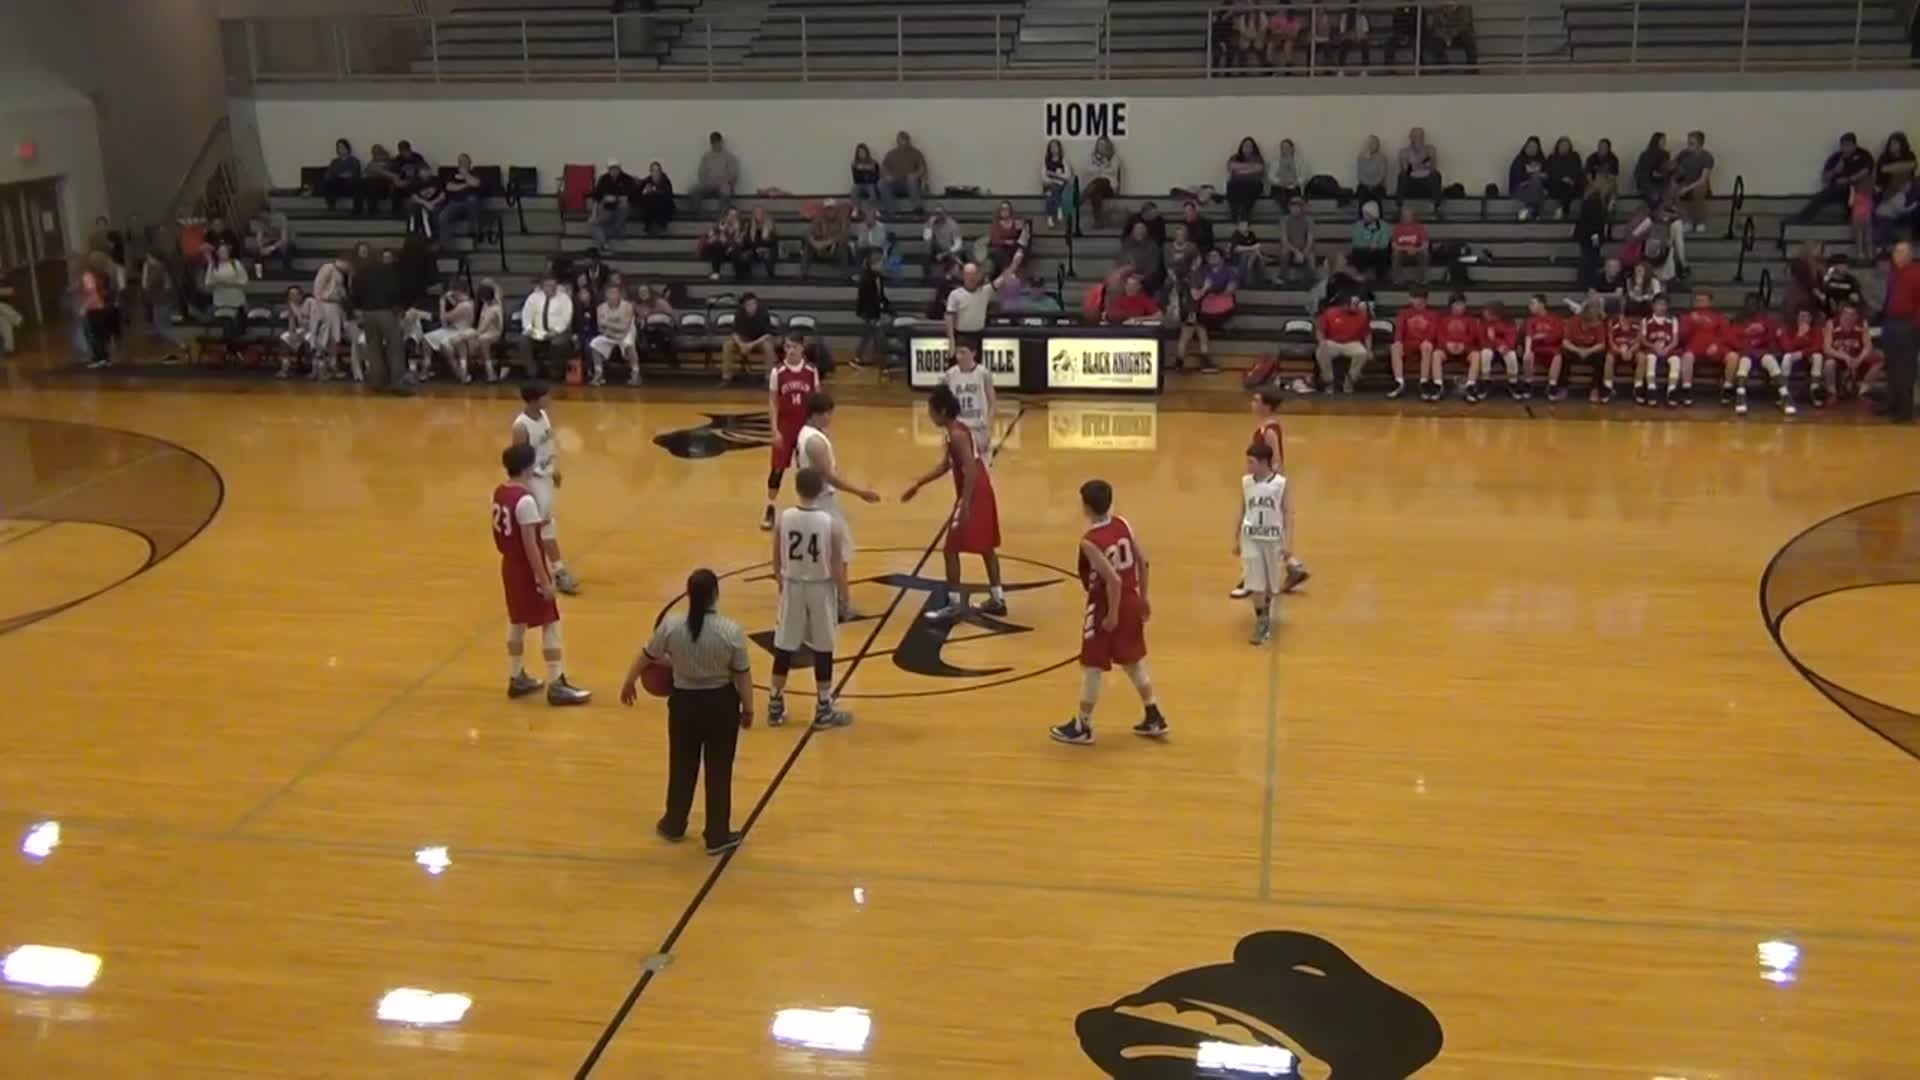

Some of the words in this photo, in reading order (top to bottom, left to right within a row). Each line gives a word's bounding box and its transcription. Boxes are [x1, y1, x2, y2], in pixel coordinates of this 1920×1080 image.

[1046, 102, 1126, 136] HOME
[1082, 351, 1110, 375] BLACK
[1112, 351, 1152, 375] KNIGHTS
[492, 503, 512, 536] 23
[1259, 511, 1264, 525] 1
[789, 530, 820, 562] 24
